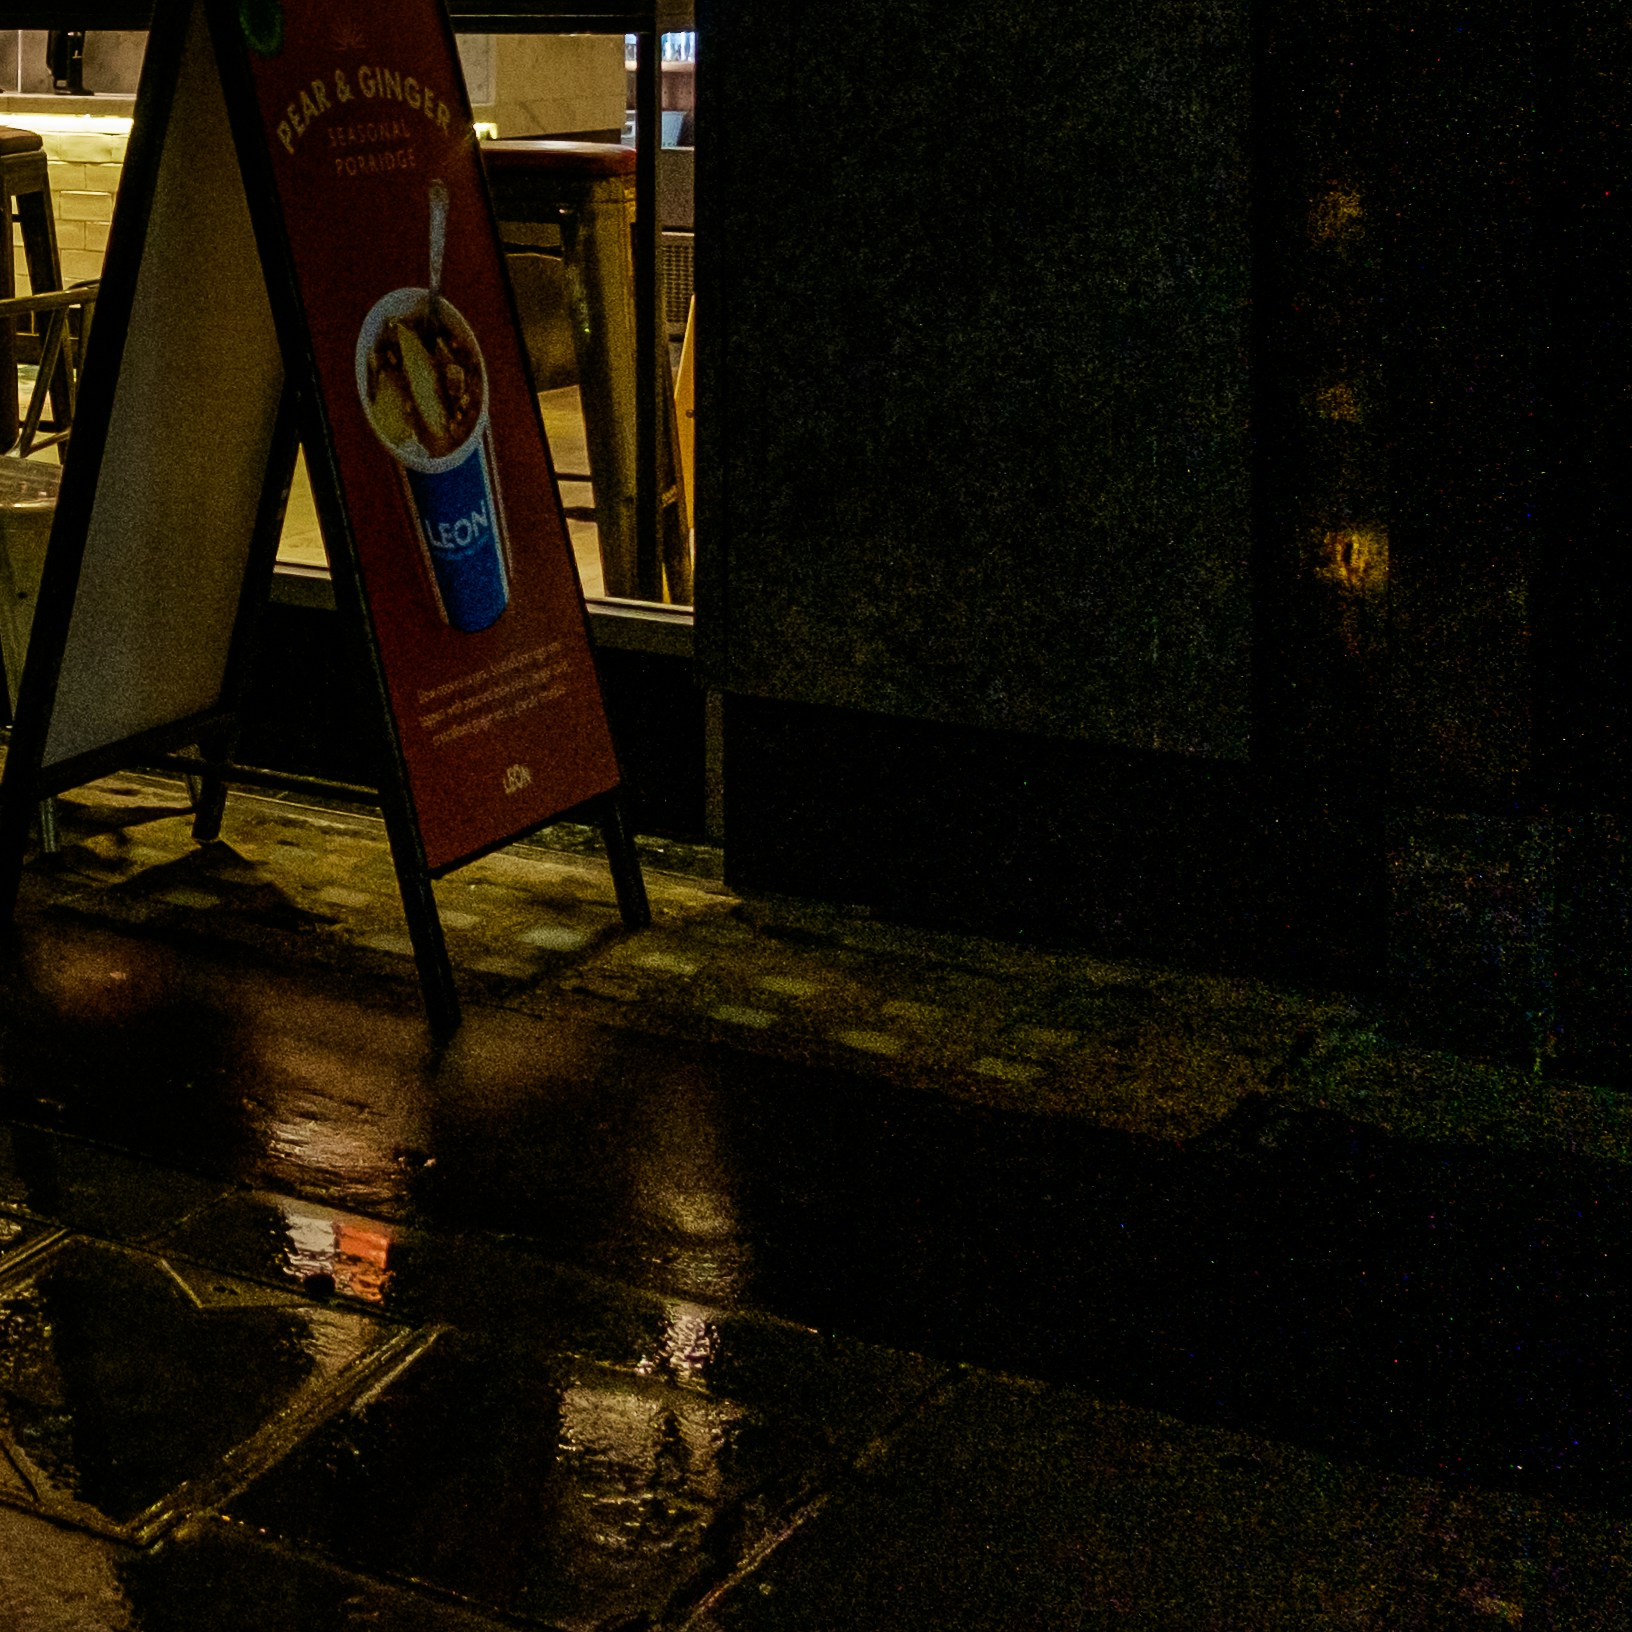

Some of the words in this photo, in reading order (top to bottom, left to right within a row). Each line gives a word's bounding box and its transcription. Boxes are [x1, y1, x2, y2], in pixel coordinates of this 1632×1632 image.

[275, 78, 332, 156] PEAR
[333, 69, 355, 103] &
[357, 64, 451, 138] GINGER
[327, 119, 412, 147] SEASONAL
[335, 148, 417, 177] PORRIDGE
[425, 498, 488, 550] LEON
